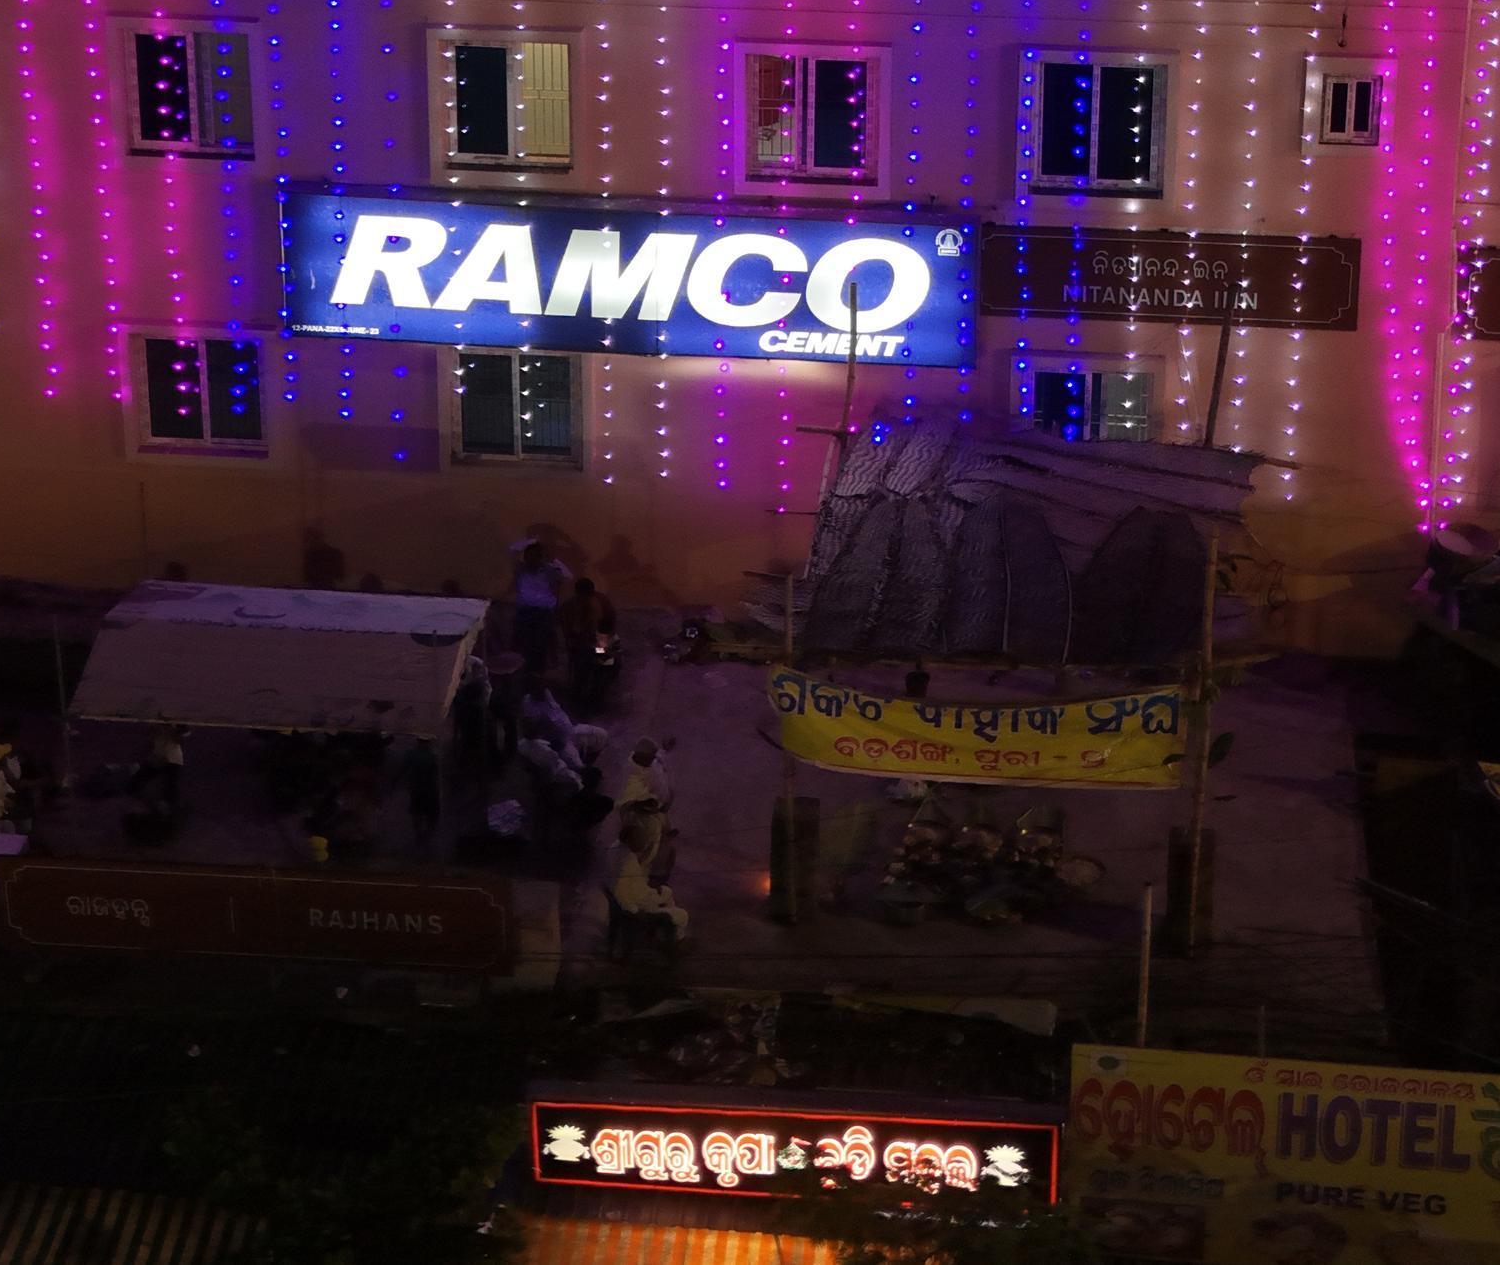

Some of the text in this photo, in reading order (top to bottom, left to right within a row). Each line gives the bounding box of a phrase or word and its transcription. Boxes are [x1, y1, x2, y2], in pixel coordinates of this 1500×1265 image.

[330, 214, 932, 335] RAMCO
[759, 330, 905, 359] CEMENT
[308, 907, 446, 935] RAJHANS
[1275, 1091, 1472, 1172] HOTEL
[1275, 1181, 1448, 1217] PURE VEG
